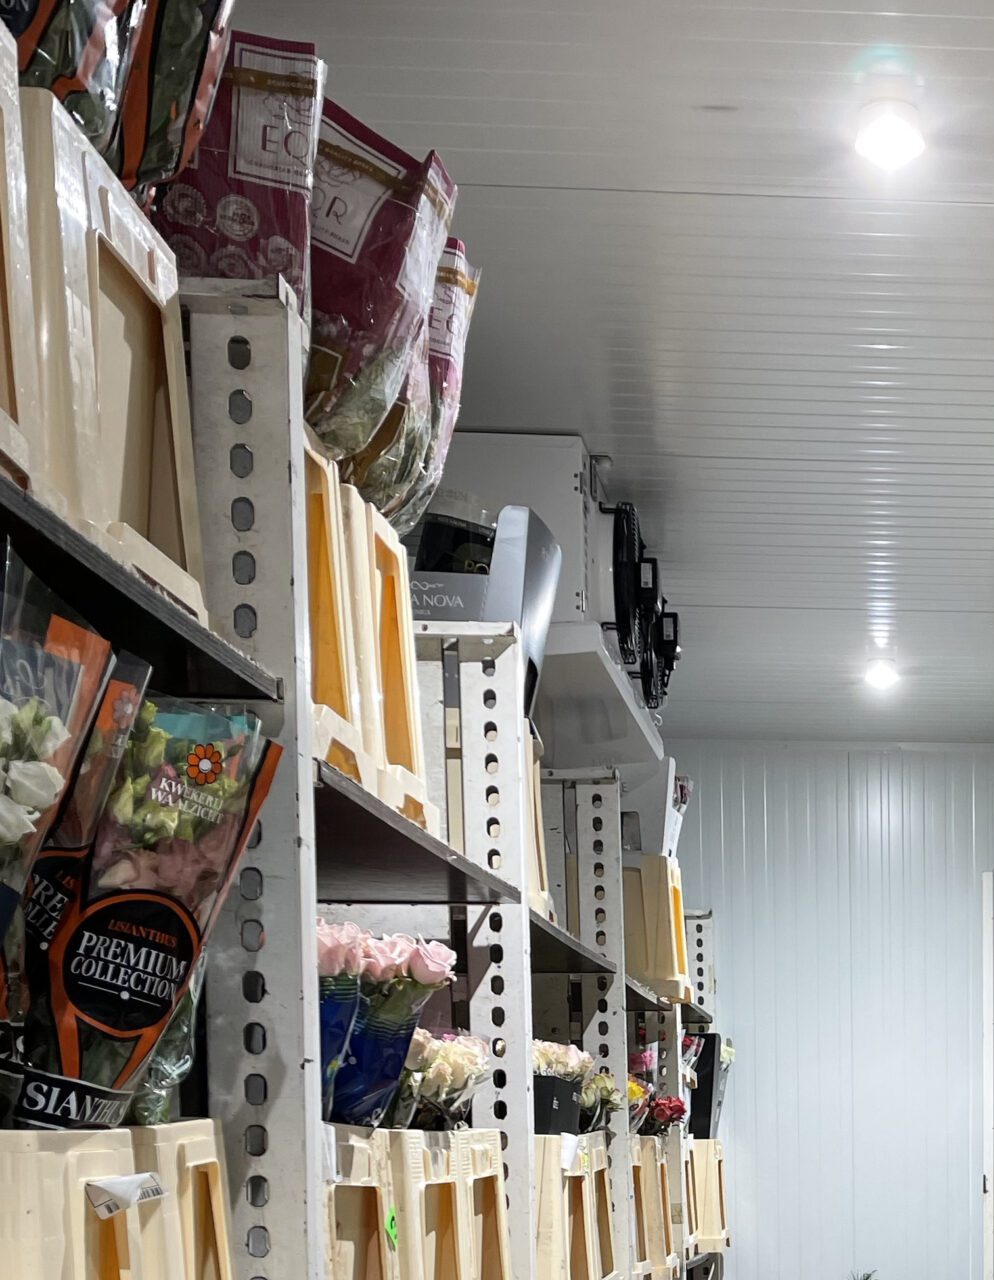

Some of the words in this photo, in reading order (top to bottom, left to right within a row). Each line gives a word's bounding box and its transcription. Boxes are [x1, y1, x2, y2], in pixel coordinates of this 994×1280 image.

[422, 594, 464, 609] NOVA
[107, 918, 178, 948] LISIANTHUS
[75, 930, 187, 982] PREMIUM
[70, 955, 177, 1000] COLLECTION
